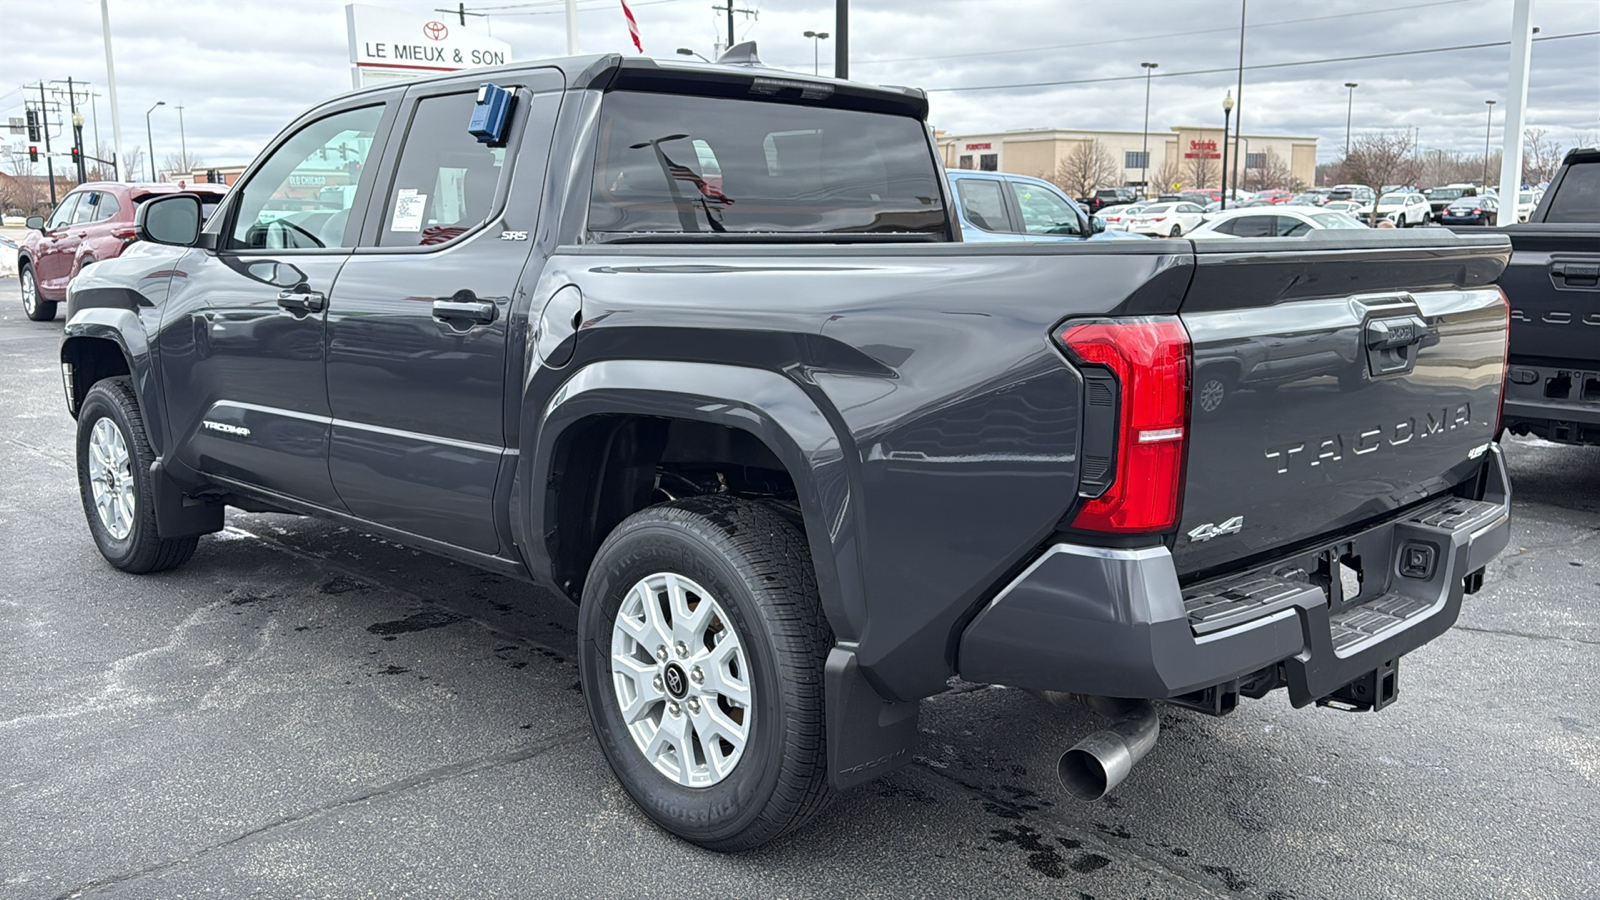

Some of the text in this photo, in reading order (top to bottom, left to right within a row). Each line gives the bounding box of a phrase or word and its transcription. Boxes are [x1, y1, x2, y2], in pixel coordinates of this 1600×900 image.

[365, 42, 504, 65] LE MIEUX & SON
[500, 231, 529, 241] SR5
[202, 420, 251, 437] TACOMA
[1264, 402, 1471, 474] TACOMA
